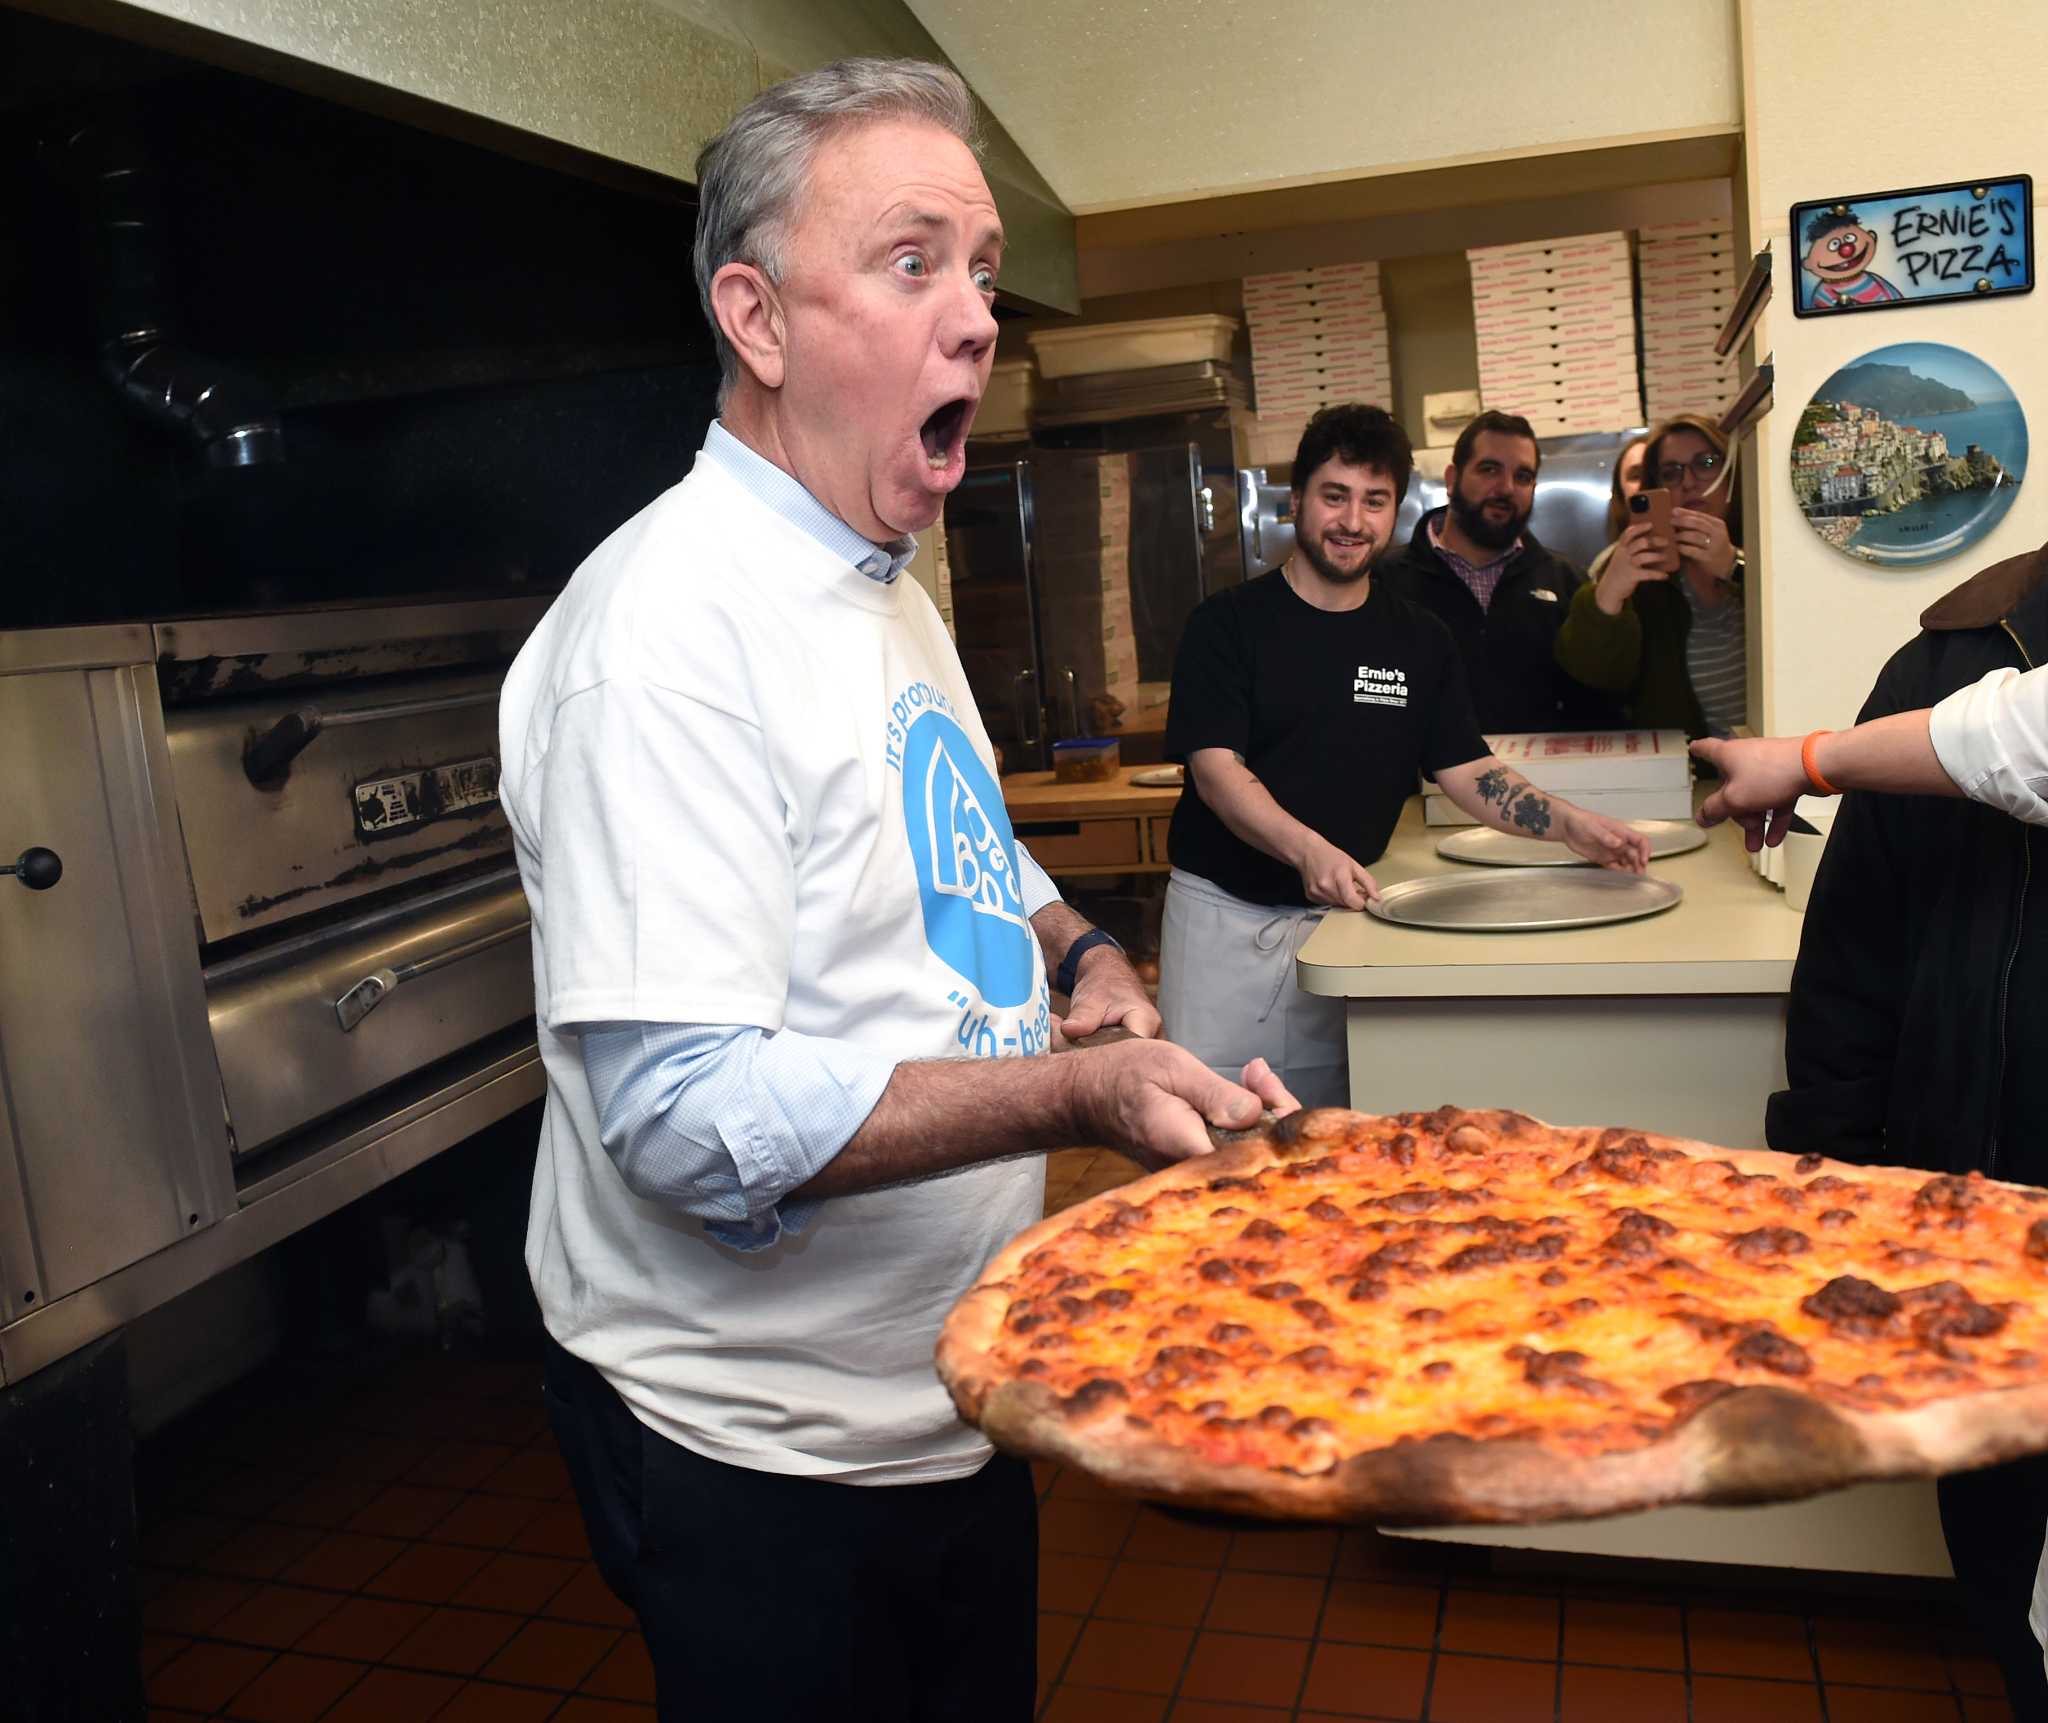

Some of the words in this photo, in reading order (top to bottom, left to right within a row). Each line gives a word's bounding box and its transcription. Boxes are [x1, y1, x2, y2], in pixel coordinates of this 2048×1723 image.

[1891, 197, 2016, 248] ERNIE'S
[1897, 243, 2020, 287] PIZZA
[1353, 679, 1408, 696] Pizzeria
[1358, 666, 1406, 682] Ernie's
